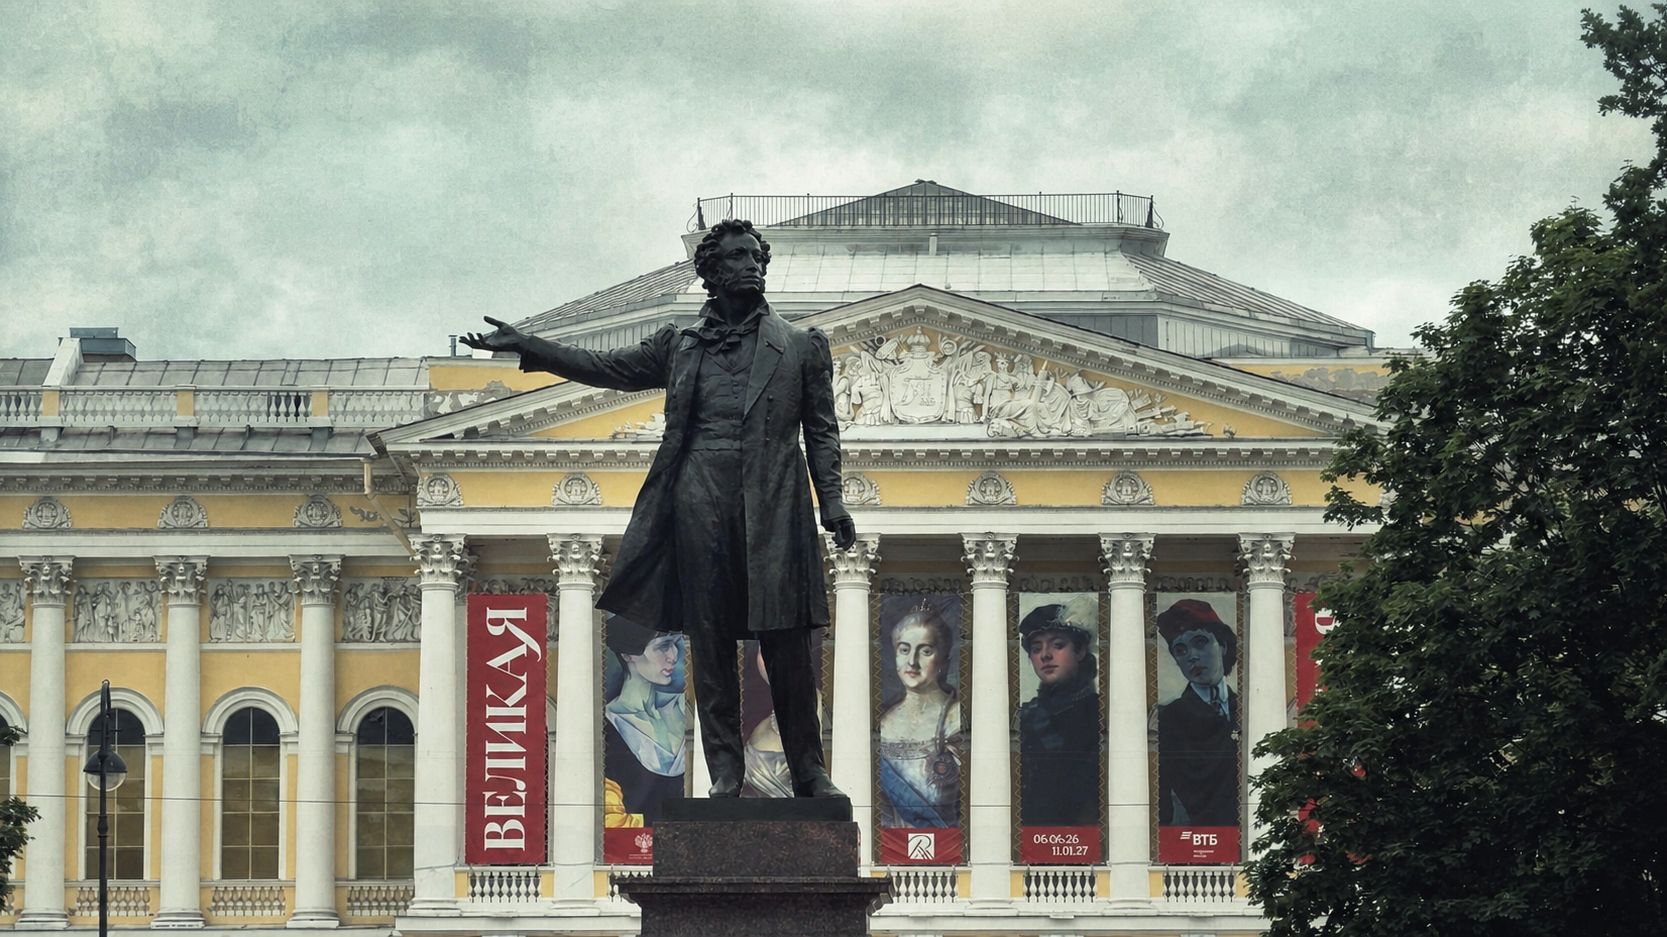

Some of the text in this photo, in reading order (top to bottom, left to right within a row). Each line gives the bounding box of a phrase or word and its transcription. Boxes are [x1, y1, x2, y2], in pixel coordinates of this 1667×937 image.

[482, 606, 542, 852] ВЕЛИКАЯ
[1192, 833, 1218, 846] ВТБ
[1052, 845, 1089, 856] 11.01.27
